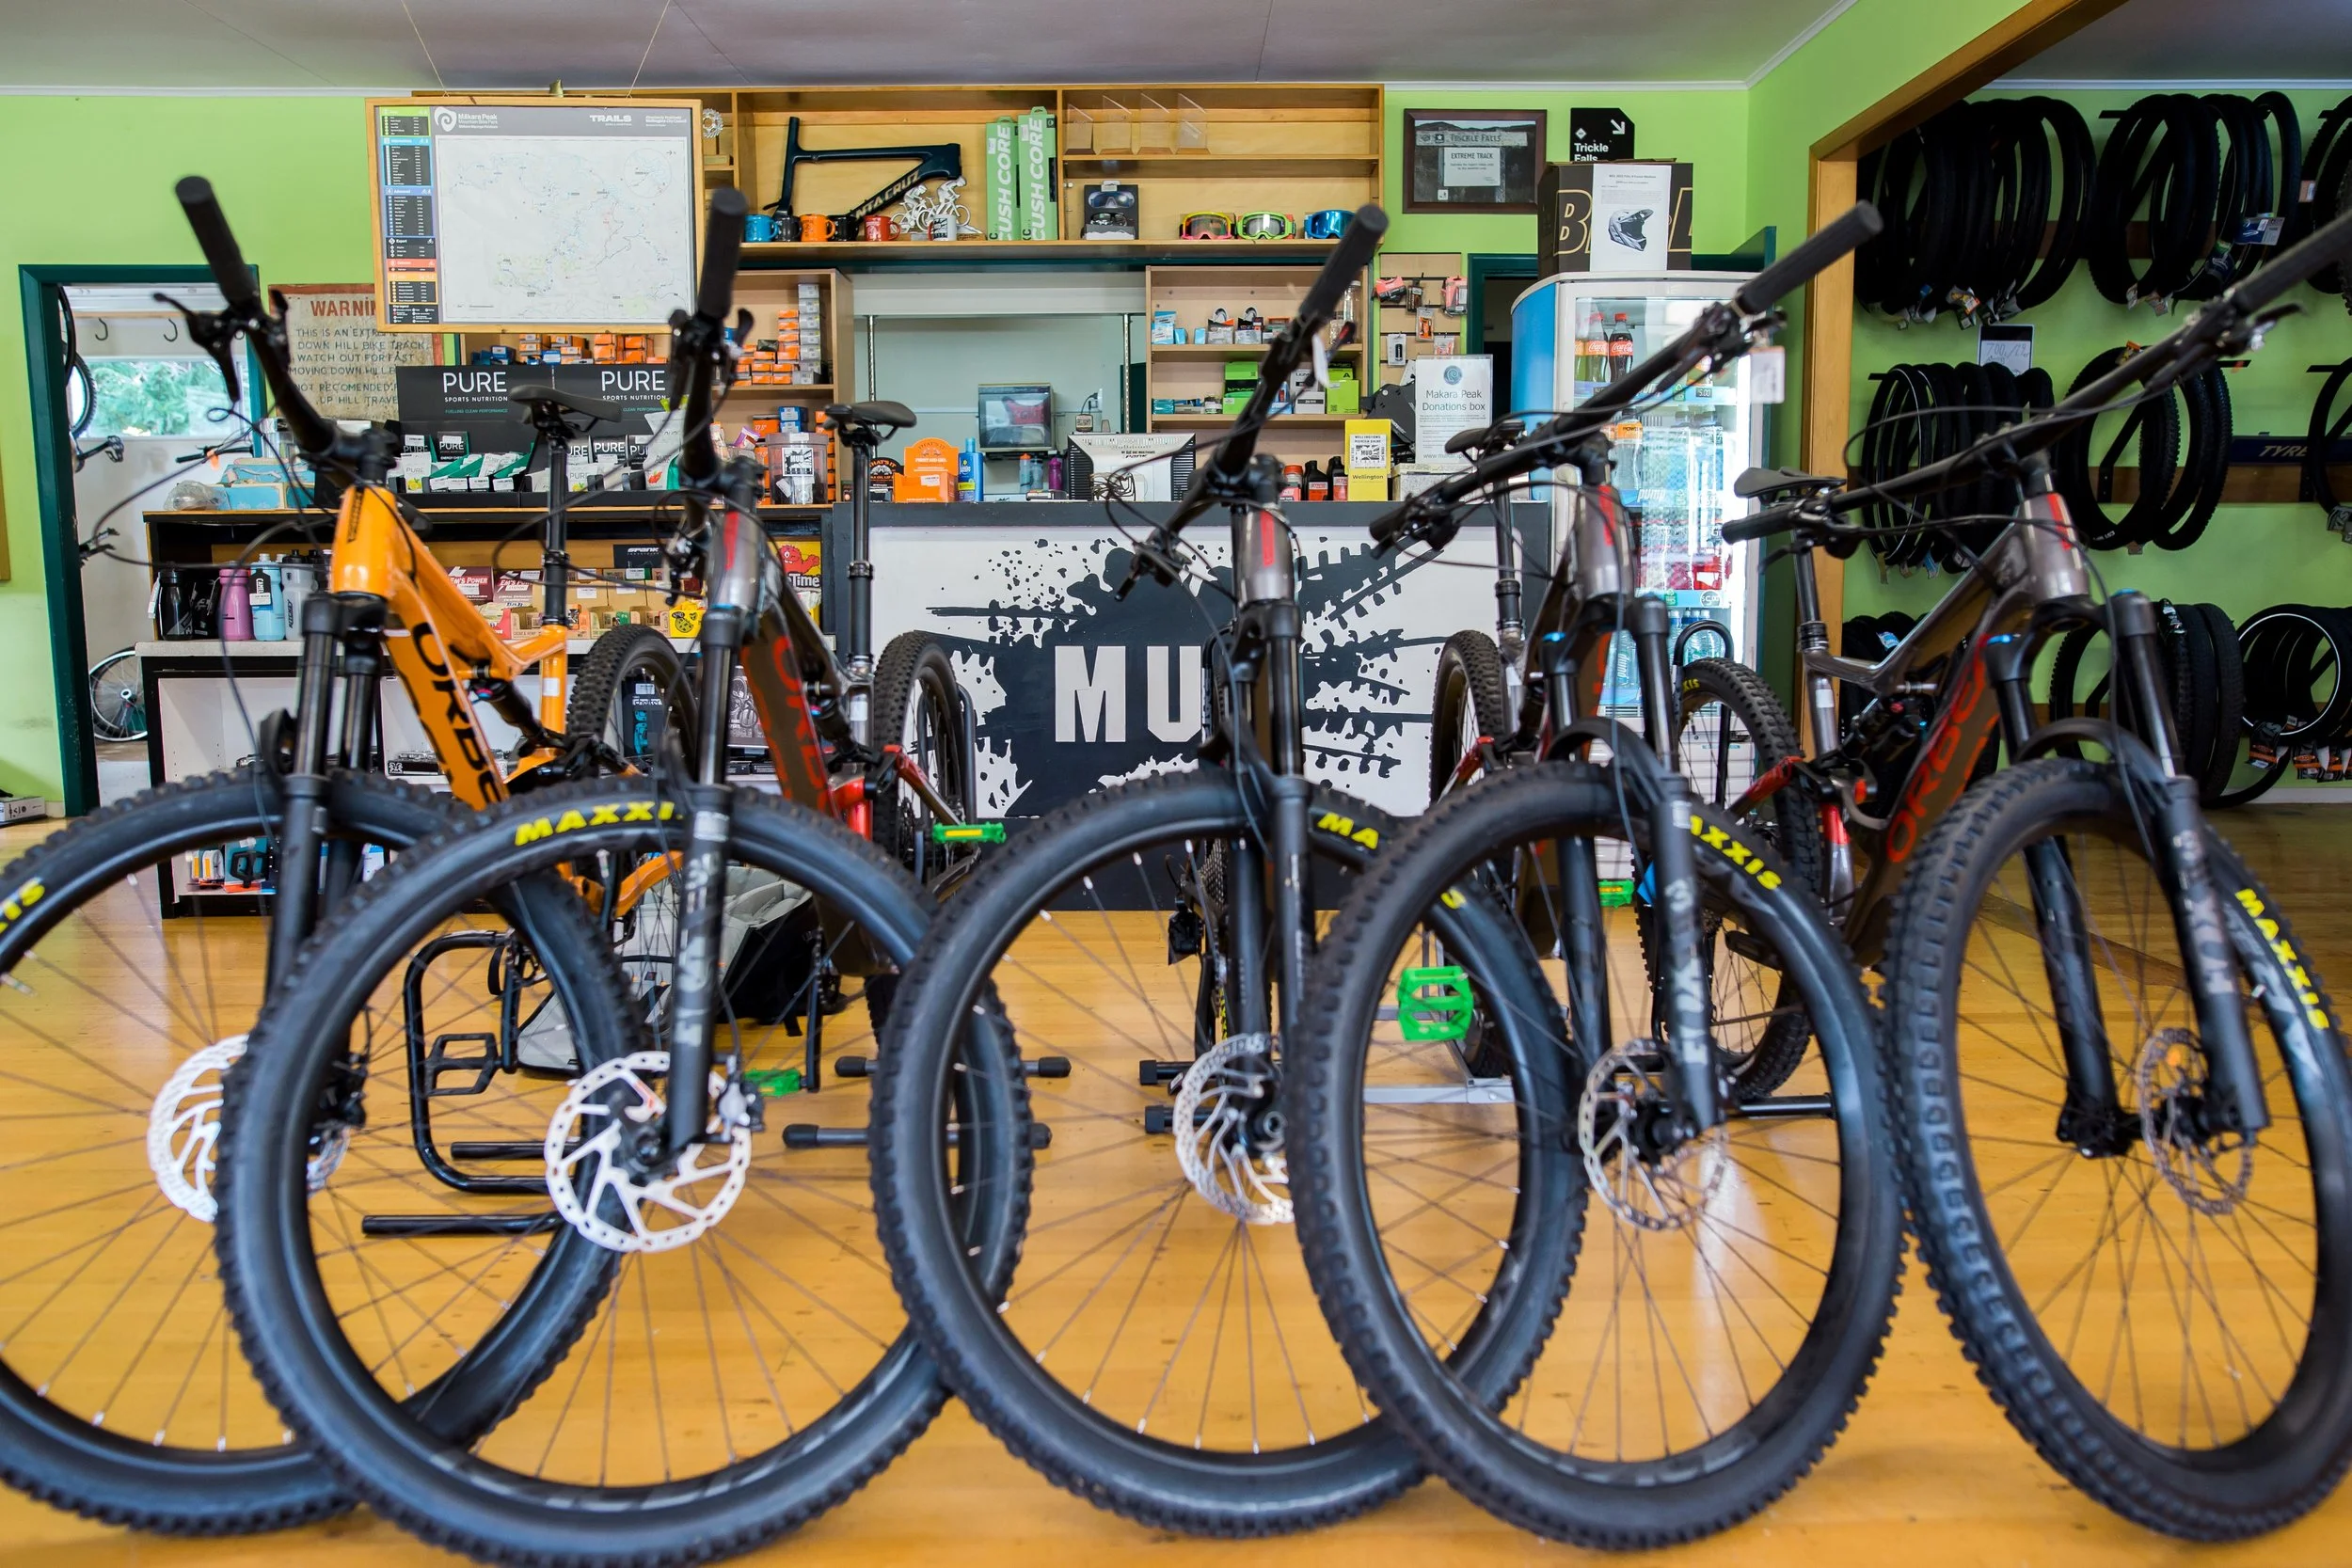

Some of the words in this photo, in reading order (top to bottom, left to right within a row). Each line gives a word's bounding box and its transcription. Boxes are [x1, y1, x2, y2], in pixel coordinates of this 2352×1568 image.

[589, 114, 632, 123] TRAILS
[1028, 118, 1044, 180] CORE
[1573, 143, 1610, 152] Trickle
[997, 125, 1011, 185] CORE
[884, 169, 920, 201] CRUZ
[1030, 182, 1046, 241] CUSH
[296, 328, 318, 337] THIS
[323, 328, 330, 337] IS
[334, 328, 349, 337] AN
[297, 341, 330, 350] DOWN
[335, 341, 358, 350] HILL
[362, 341, 386, 350] BIKE
[297, 354, 335, 363] WATCH
[340, 354, 361, 362] OUT
[364, 354, 385, 362] FOR
[288, 366, 327, 375] MOVING
[331, 366, 362, 375] DOWN
[442, 372, 507, 392] PURE
[601, 370, 666, 391] PURE
[1425, 389, 1458, 399] Makara
[1461, 389, 1482, 399] Peak
[320, 396, 333, 404] UP
[338, 396, 359, 404] HILL
[364, 396, 398, 406] TRAVE
[1422, 402, 1467, 411] Donations
[1470, 402, 1486, 411] box
[439, 441, 465, 451] PURE
[567, 445, 588, 456] URE
[595, 442, 626, 452] PURE
[1637, 488, 1666, 502] pump
[789, 573, 820, 587] Time
[514, 800, 683, 847] MAXXI
[2234, 888, 2329, 1030] MAXXIS
